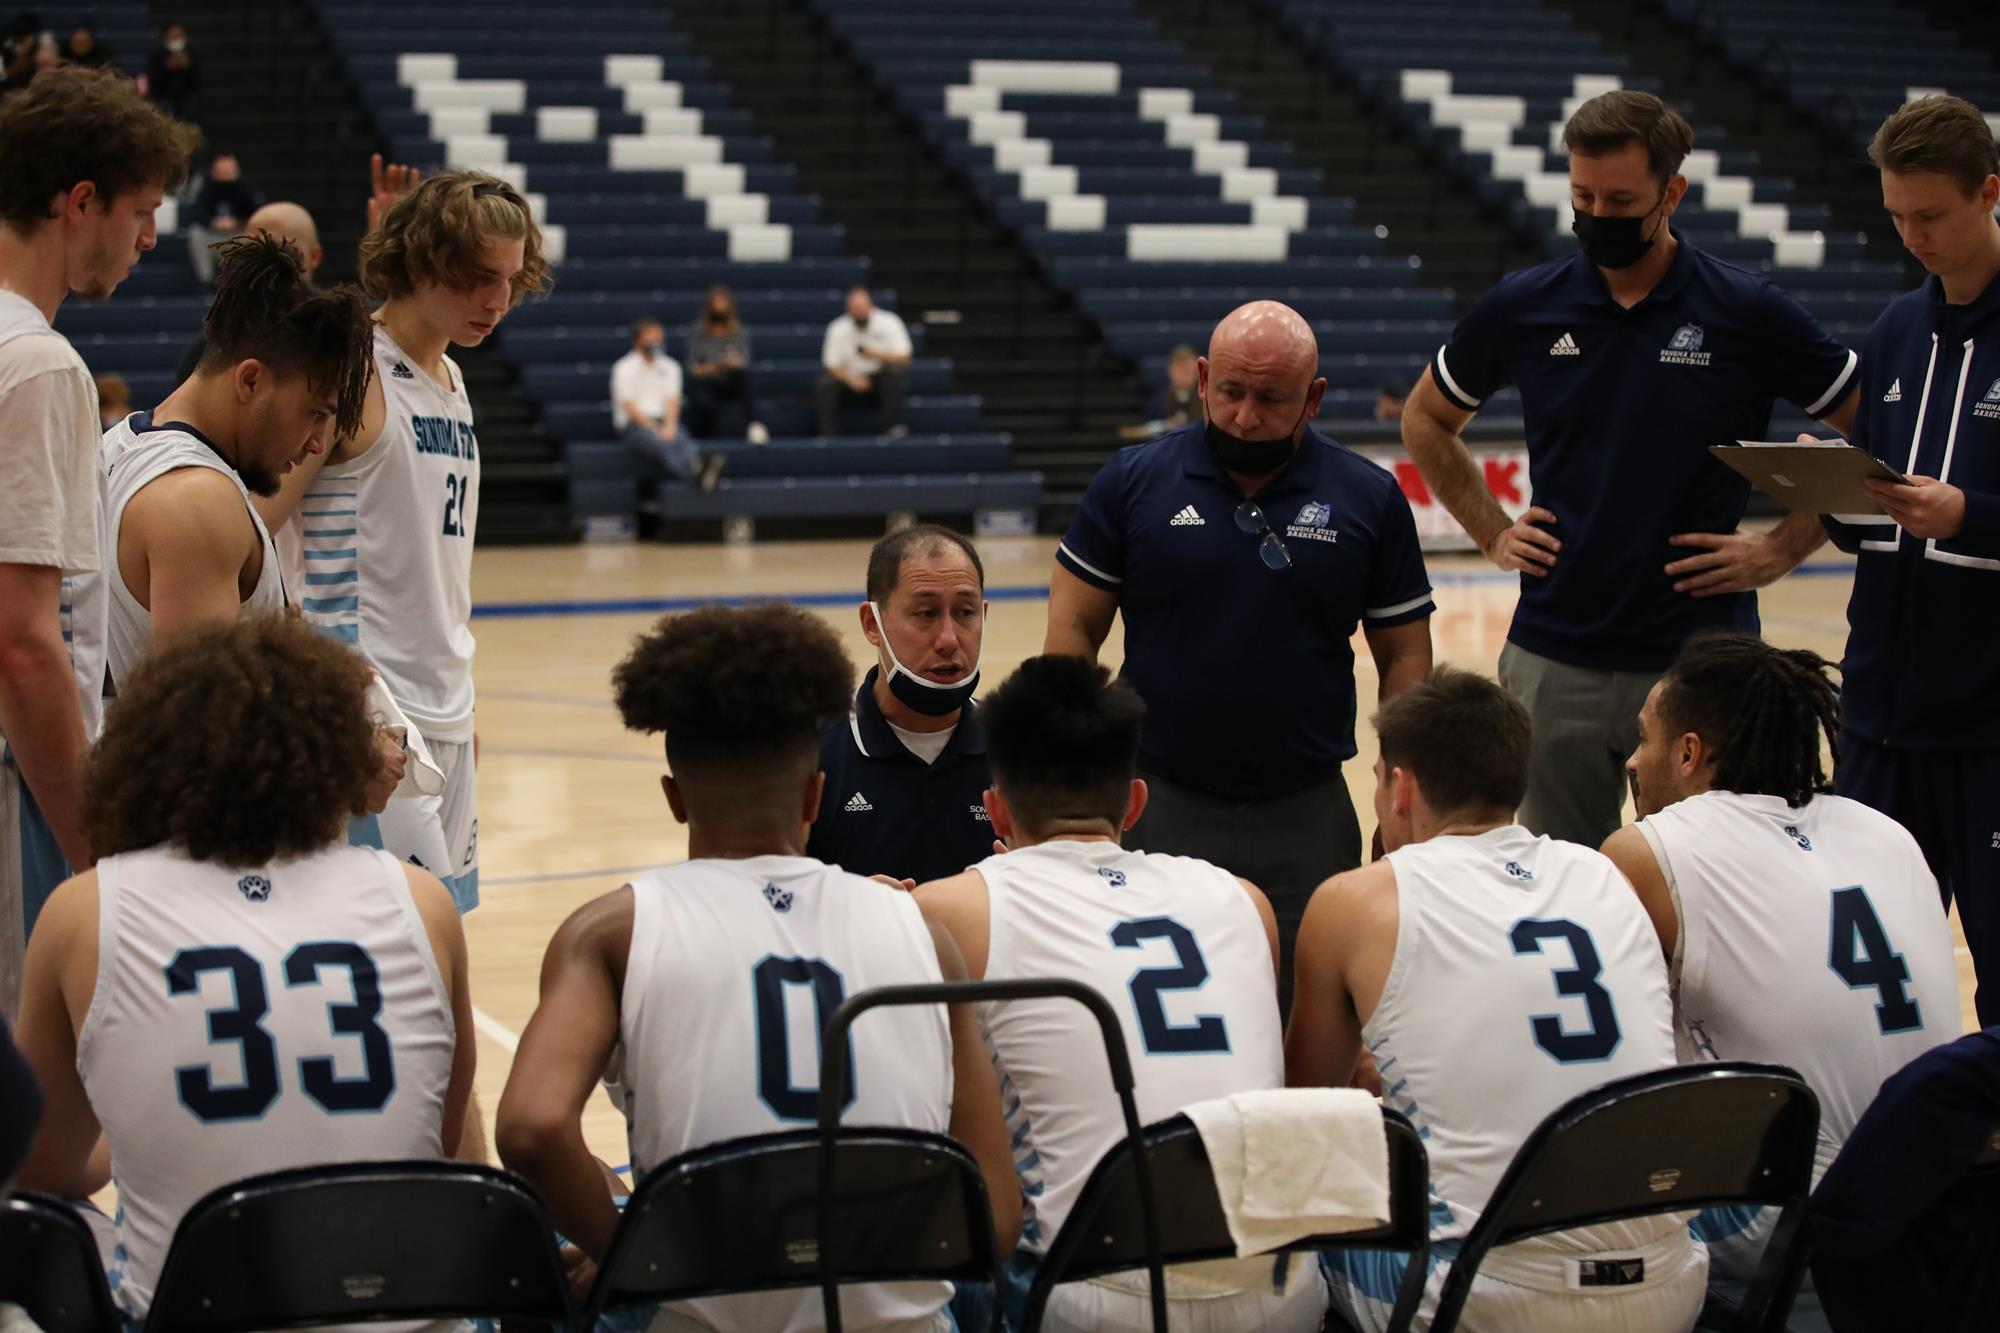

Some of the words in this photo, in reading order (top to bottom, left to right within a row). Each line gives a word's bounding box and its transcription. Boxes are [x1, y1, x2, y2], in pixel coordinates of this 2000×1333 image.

[1659, 350, 1688, 358] SONOMA
[1690, 352, 1712, 360] STATE
[1659, 356, 1710, 366] BASKETBALL
[1973, 409, 2000, 420] BASKE
[442, 472, 467, 537] 21
[1286, 525, 1314, 533] SONOMA
[1316, 528, 1338, 537] STATE
[1286, 531, 1337, 543] BASKETBALL
[970, 805, 987, 813] SON
[975, 813, 992, 821] BAS
[1827, 884, 1924, 1036] 4
[1107, 915, 1232, 1056] 2
[1507, 917, 1624, 1065] 3
[163, 940, 396, 1123] 33
[752, 953, 857, 1122] 0
